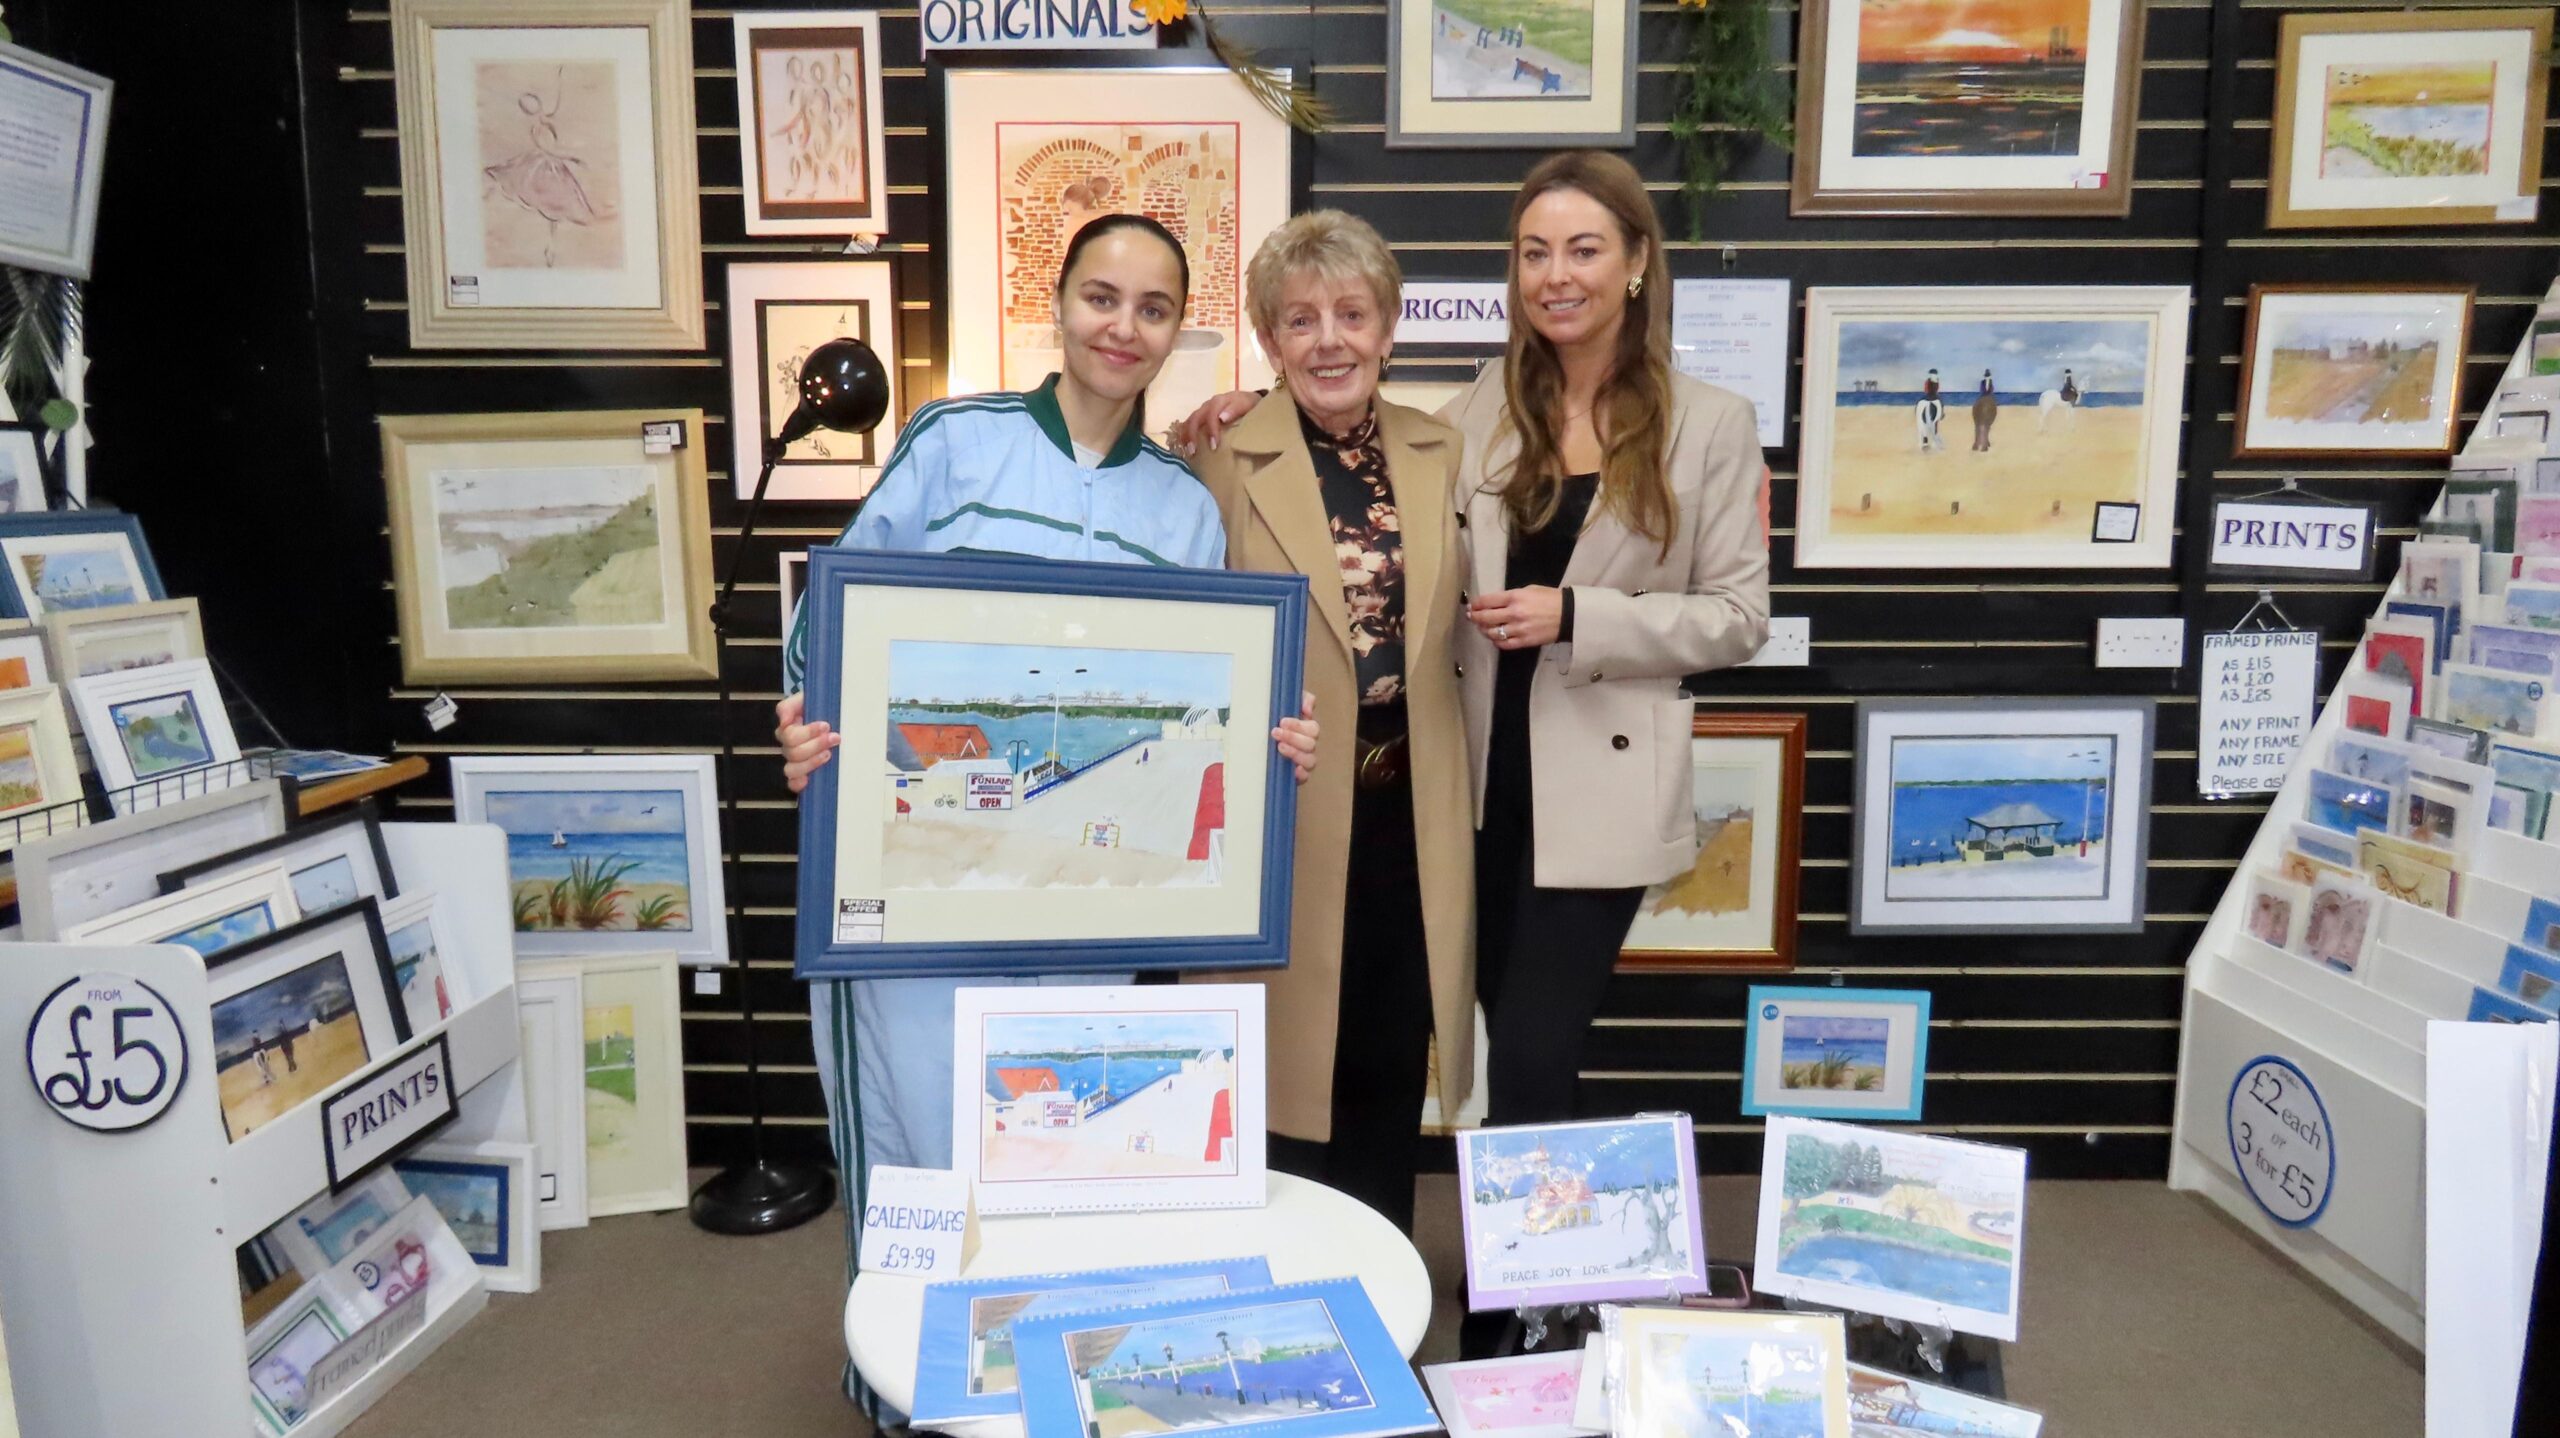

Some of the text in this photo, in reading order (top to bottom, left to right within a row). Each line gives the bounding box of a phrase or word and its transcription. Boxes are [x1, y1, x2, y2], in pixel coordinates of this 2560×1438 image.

[924, 0, 1153, 43] ORIGINALS
[1401, 298, 1505, 321] RIGINA
[2219, 519, 2356, 551] PRINTS
[2205, 633, 2315, 648] FRAMED PRINTS
[2222, 656, 2272, 671] A5 £15
[2221, 672, 2274, 687] A4 £20
[2220, 688, 2272, 703] A3 £25
[2220, 716, 2300, 731] ANY PRINT
[2218, 734, 2300, 750] ANY FRAME
[2217, 753, 2285, 768] ANY SIZE
[2211, 774, 2258, 790] Please
[980, 797, 1002, 808] OPEN
[87, 989, 122, 1001] FROM
[45, 1005, 167, 1110] £5
[341, 1062, 439, 1150] PRINTS
[2249, 1070, 2321, 1150] £2 each
[2271, 1133, 2287, 1149] or
[2237, 1122, 2314, 1209] 3 for £5
[865, 1205, 965, 1232] CALENDARS
[1502, 1264, 1610, 1283] PEACE JOY LOVE
